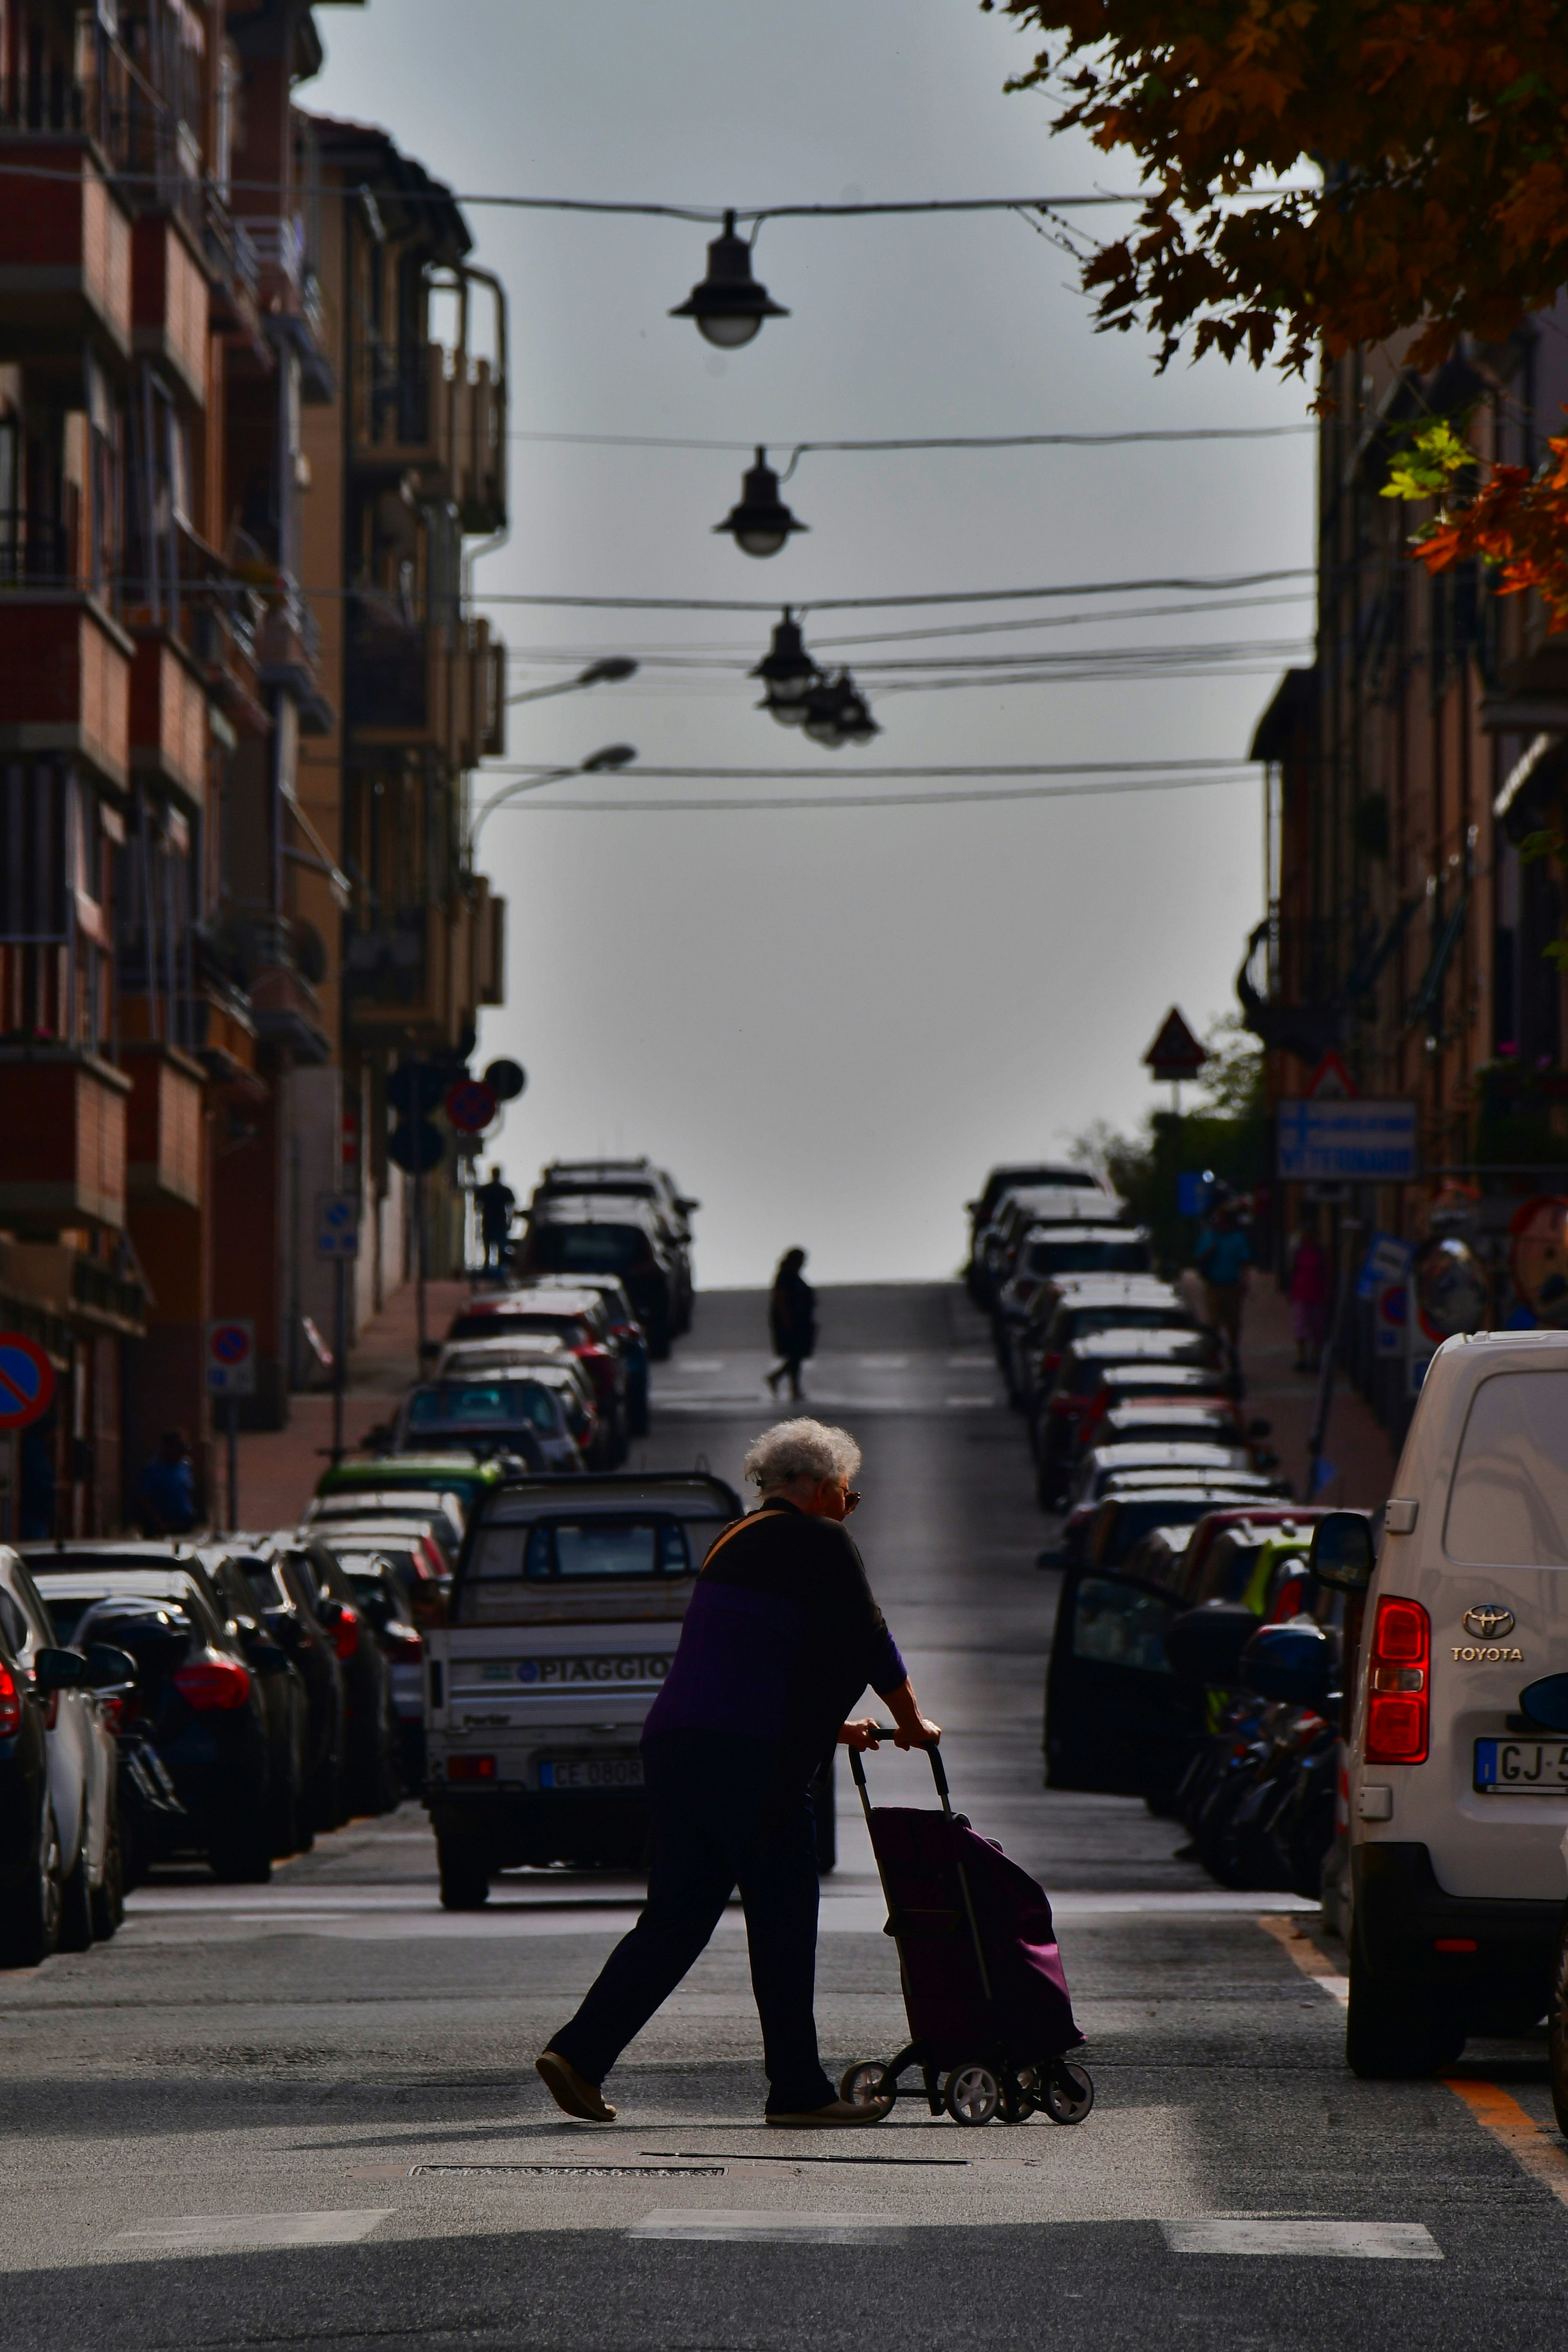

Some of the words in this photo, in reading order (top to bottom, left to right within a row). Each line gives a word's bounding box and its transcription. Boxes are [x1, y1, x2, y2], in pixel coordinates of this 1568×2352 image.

[1451, 1647, 1524, 1661] TOYOTA
[539, 1658, 670, 1682] PIAGGIO
[1502, 1746, 1542, 1780] GJ
